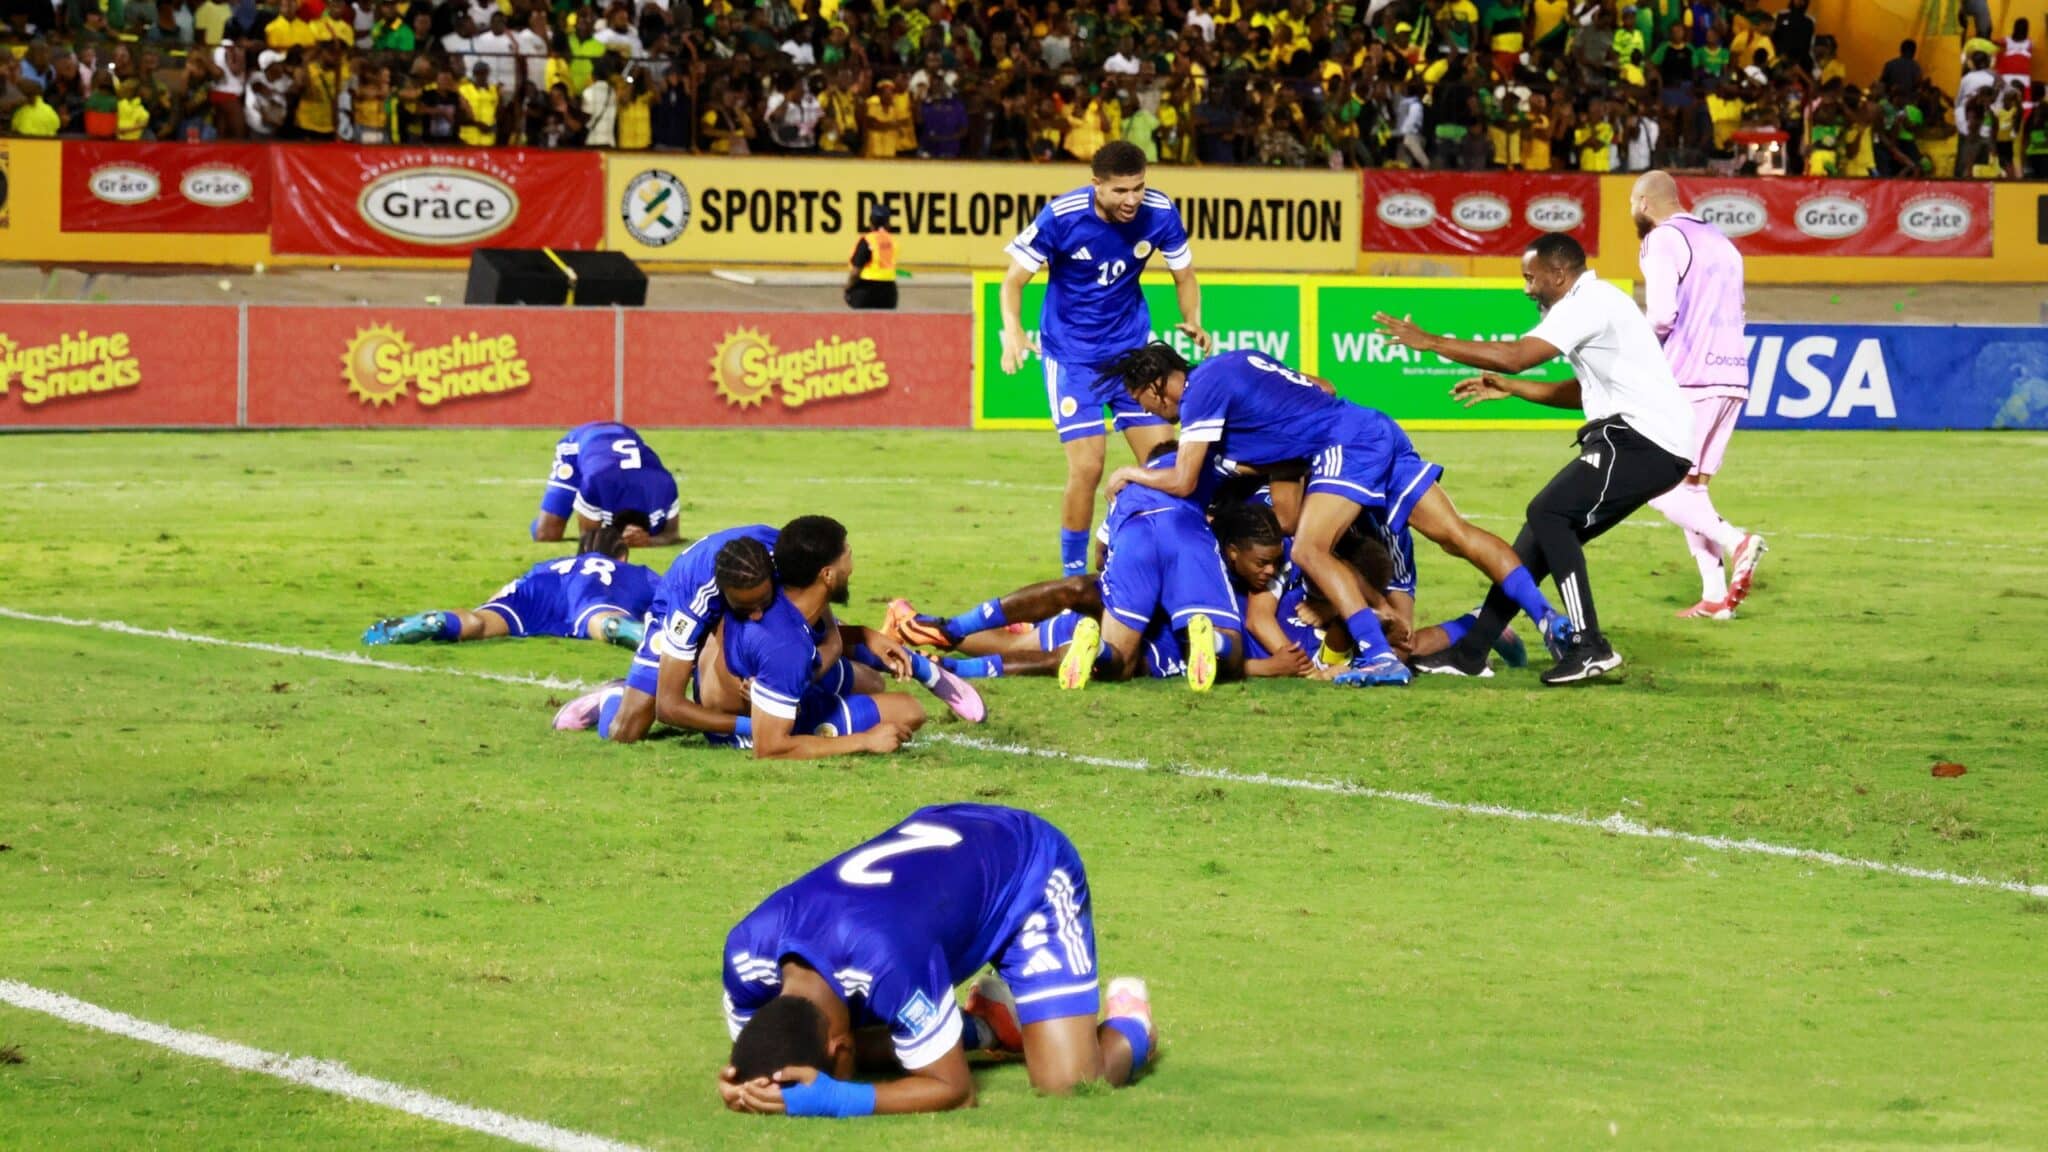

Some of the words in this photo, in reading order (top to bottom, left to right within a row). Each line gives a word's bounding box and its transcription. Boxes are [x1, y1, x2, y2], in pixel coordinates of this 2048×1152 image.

[98, 179, 148, 193] Grace
[191, 180, 241, 194] Grace
[382, 191, 495, 220] Grace
[701, 188, 842, 233] SPORTS
[857, 191, 1058, 235] DEVELOPM
[1174, 197, 1342, 242] UNDATION
[1385, 203, 1428, 218] Grace
[1460, 206, 1502, 221] Grace
[1533, 207, 1575, 222] Grace
[1702, 207, 1756, 225] Grace
[1804, 209, 1859, 226] Grace
[1909, 211, 1962, 228] Grace
[1096, 259, 1127, 287] 19
[0, 330, 130, 375] unshine
[375, 331, 518, 385] Sunshine
[741, 334, 878, 388] Sunshine
[22, 356, 141, 404] Snacks
[416, 357, 531, 405] Snacks
[781, 360, 890, 407] Snacks
[612, 439, 641, 469] 5
[837, 822, 963, 885] 2
